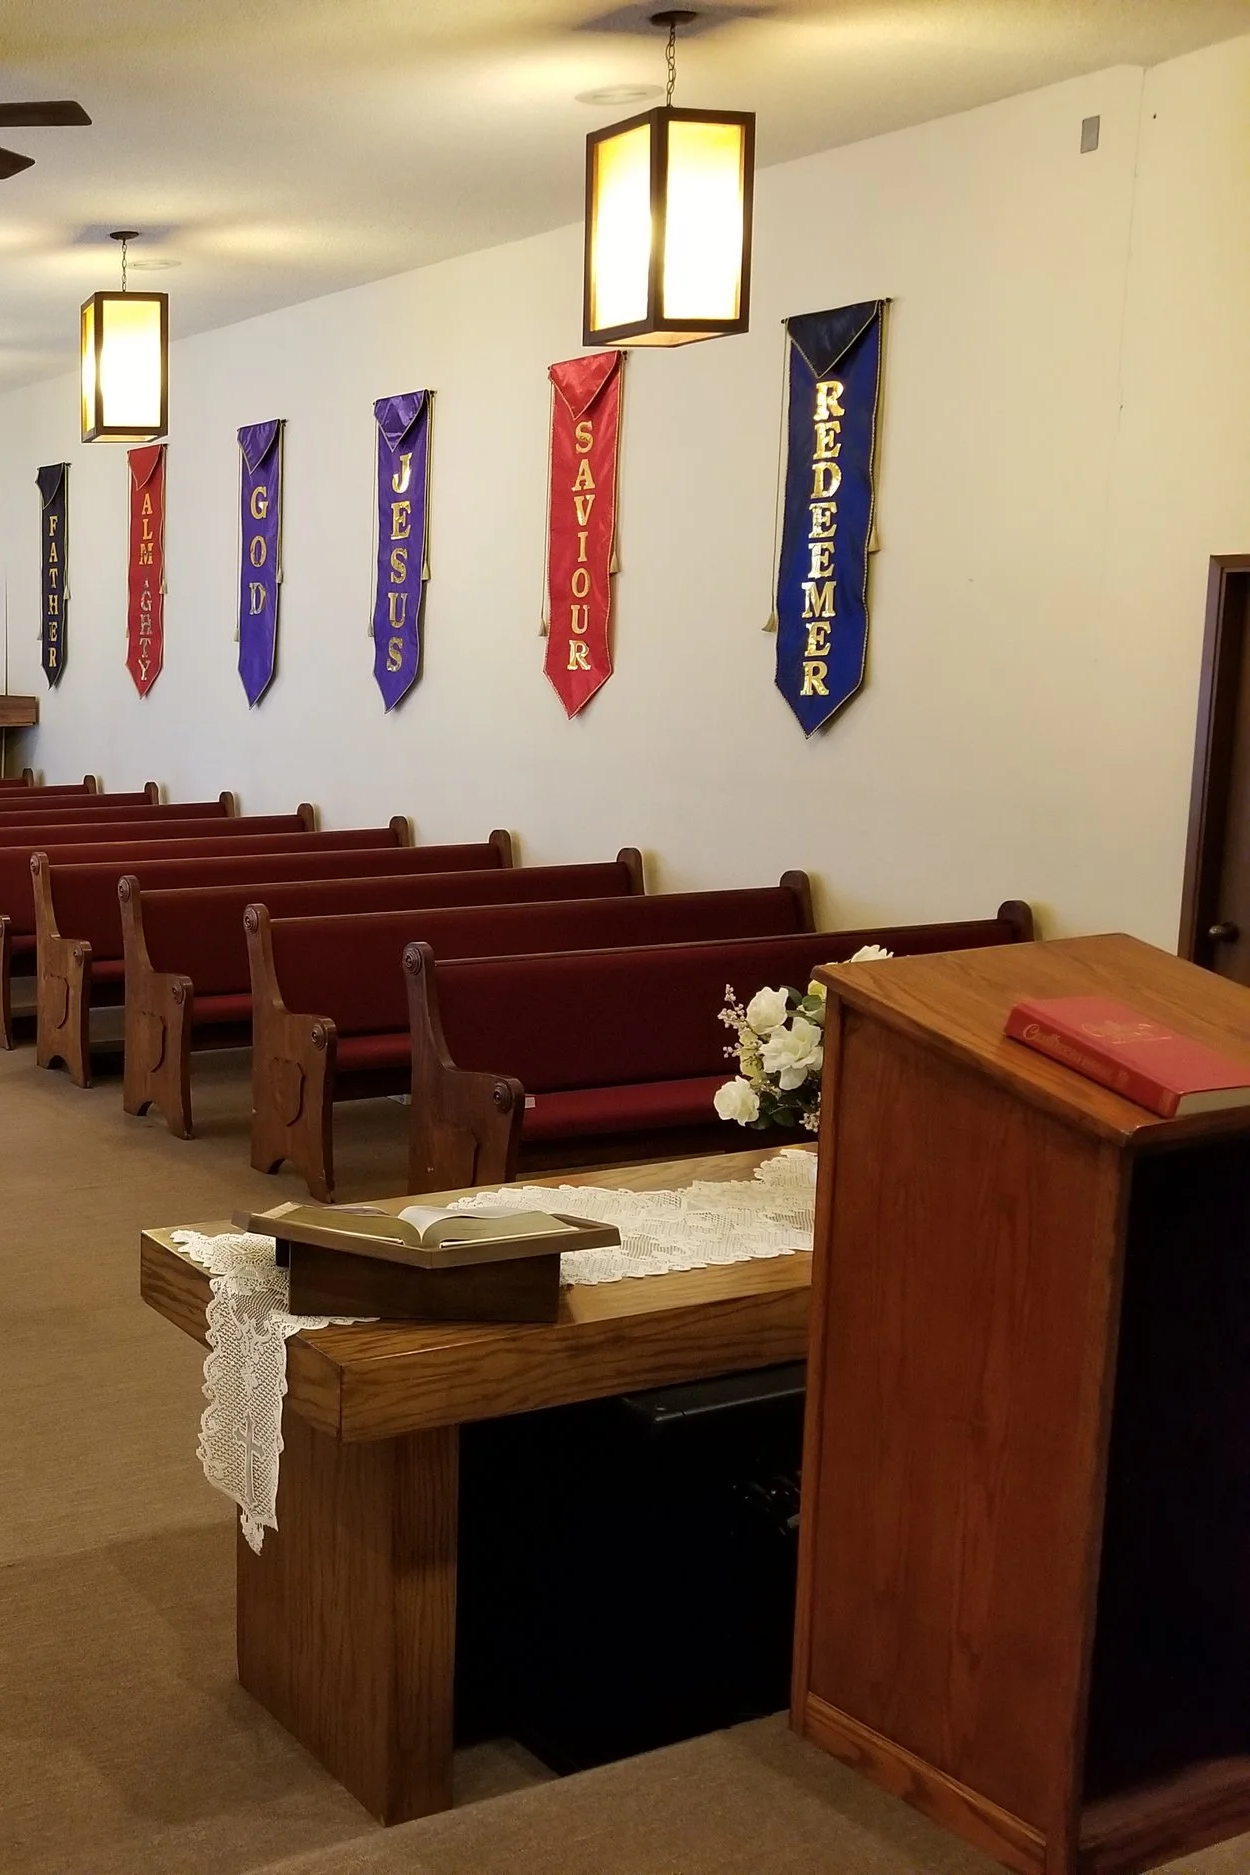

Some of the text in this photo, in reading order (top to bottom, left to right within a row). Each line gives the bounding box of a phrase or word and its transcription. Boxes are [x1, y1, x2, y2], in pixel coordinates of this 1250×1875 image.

[47, 516, 59, 668] FATHER
[249, 486, 269, 616] GOD
[386, 452, 413, 673] JESUS
[567, 420, 594, 671] SAVIOUR
[800, 380, 845, 697] REDEEMER
